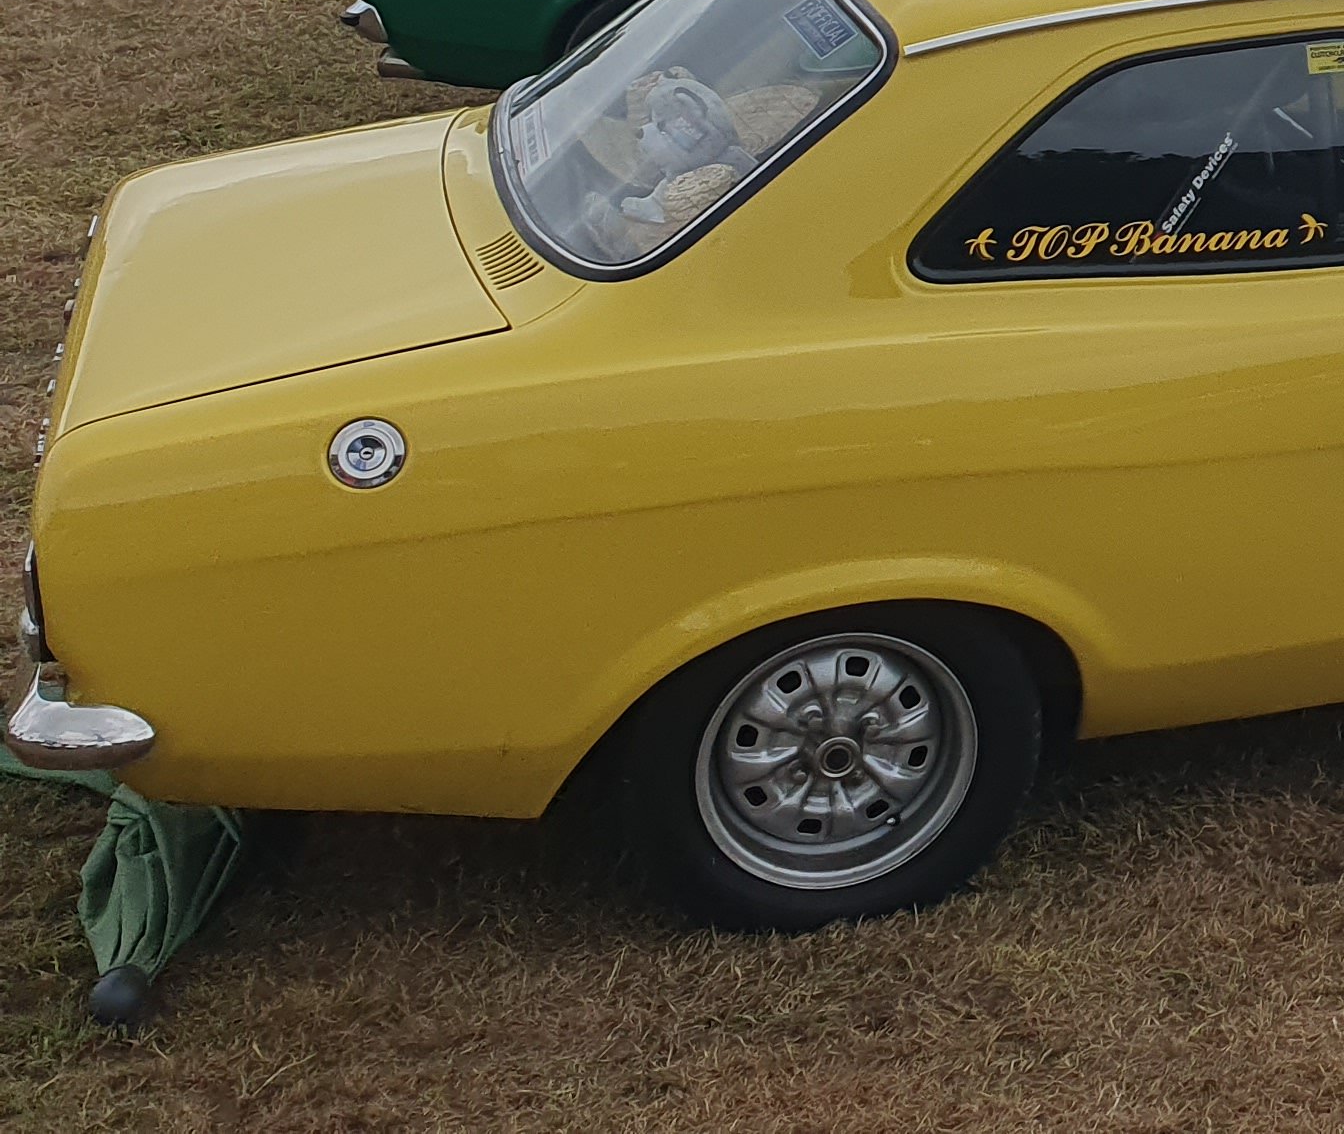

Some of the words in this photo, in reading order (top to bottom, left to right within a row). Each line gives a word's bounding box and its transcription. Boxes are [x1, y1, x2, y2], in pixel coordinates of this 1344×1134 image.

[1161, 189, 1197, 235] Safety
[1191, 131, 1235, 192] Devices
[1005, 222, 1110, 262] TOP
[1110, 219, 1290, 257] Banana
